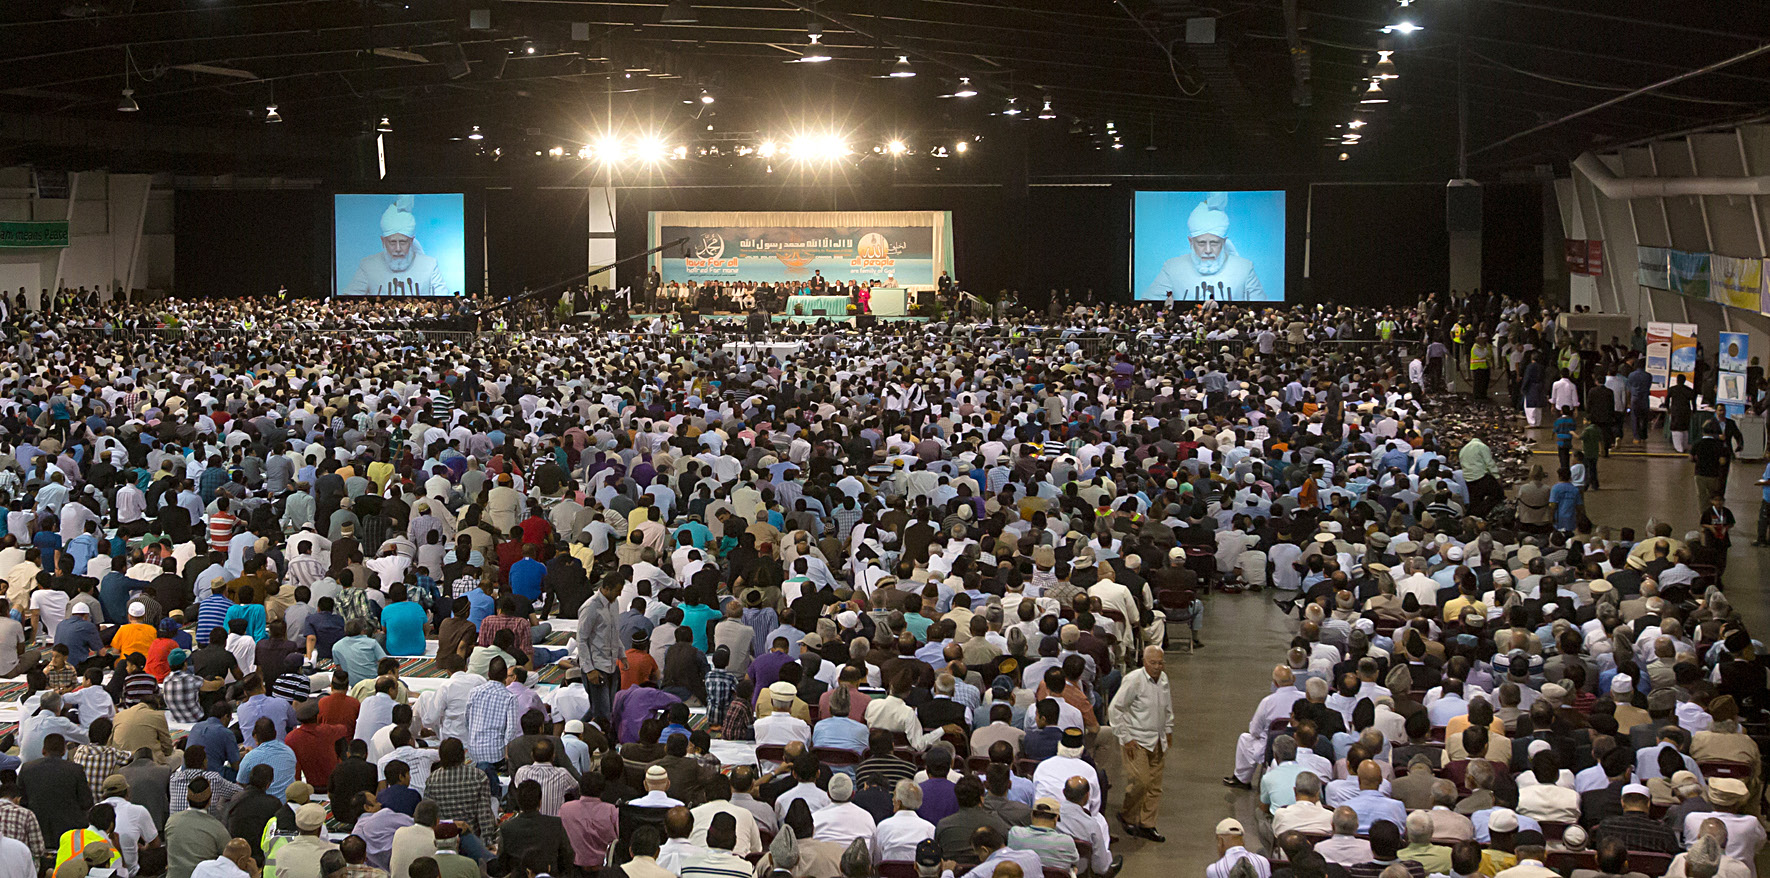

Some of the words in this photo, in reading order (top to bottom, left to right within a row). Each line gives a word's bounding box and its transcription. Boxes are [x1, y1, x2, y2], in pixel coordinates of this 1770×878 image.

[16, 231, 42, 240] means
[45, 229, 68, 240] Peace
[685, 256, 706, 267] love
[707, 257, 725, 267] for
[727, 256, 739, 267] all
[851, 256, 862, 266] all
[863, 256, 895, 268] people
